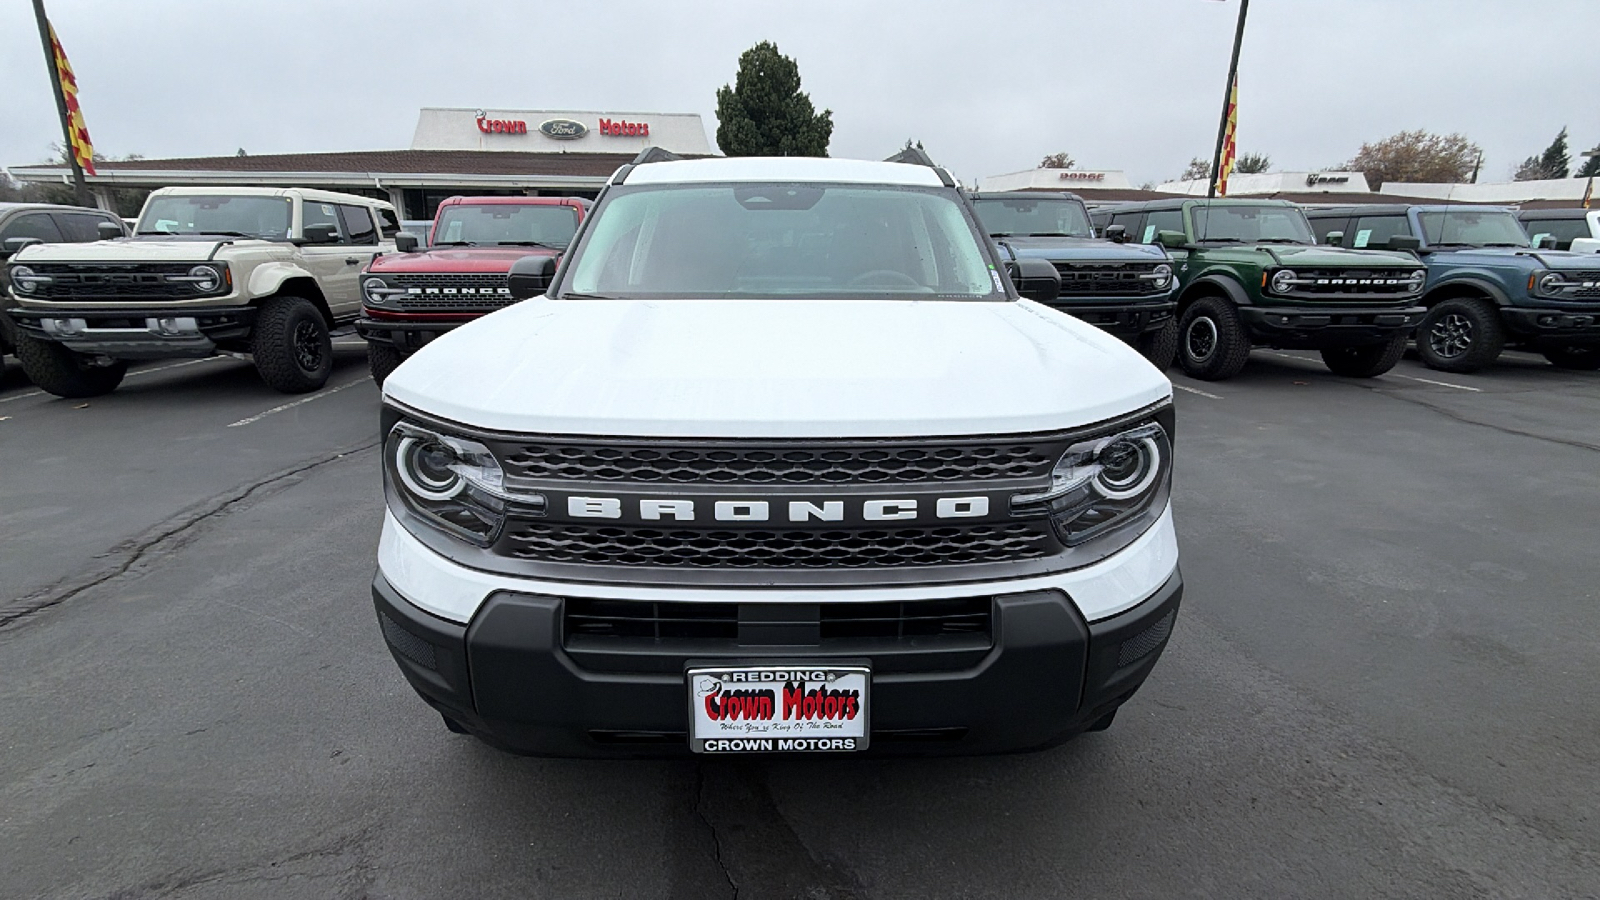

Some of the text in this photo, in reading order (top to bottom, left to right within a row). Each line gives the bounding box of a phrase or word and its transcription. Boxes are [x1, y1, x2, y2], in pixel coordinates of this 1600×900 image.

[476, 116, 527, 135] Crown
[550, 122, 576, 135] Ford
[599, 118, 649, 136] Motors
[1060, 172, 1105, 181] DODGE
[567, 496, 990, 522] BRONCO
[732, 671, 827, 682] REDDING
[704, 683, 860, 721] Crown Motors
[720, 721, 844, 733] Where You're King Of The Road
[704, 738, 856, 751] CROWN MOTORS
